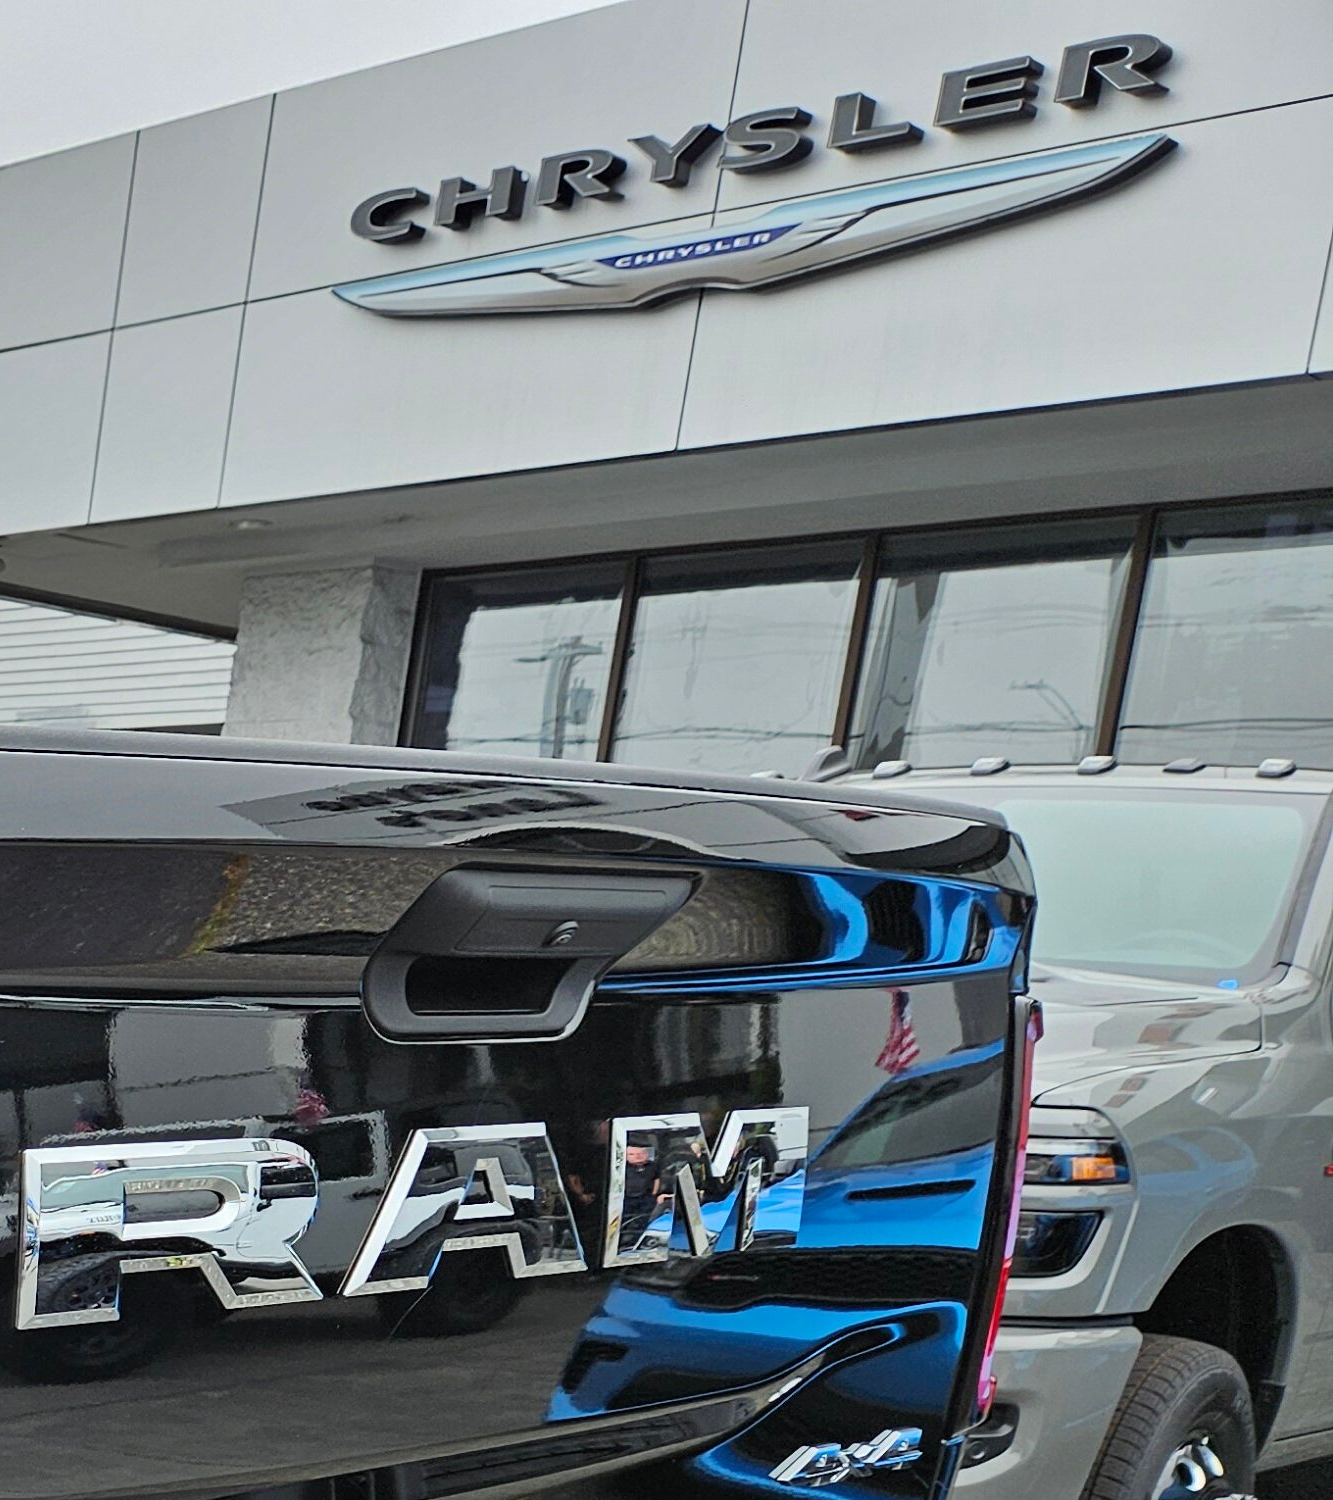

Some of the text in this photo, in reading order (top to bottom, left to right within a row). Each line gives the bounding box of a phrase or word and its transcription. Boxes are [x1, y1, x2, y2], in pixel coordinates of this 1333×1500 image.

[349, 34, 1173, 244] CHRYSLER
[614, 232, 771, 268] CHRYSLER
[17, 1106, 809, 1330] RAM
